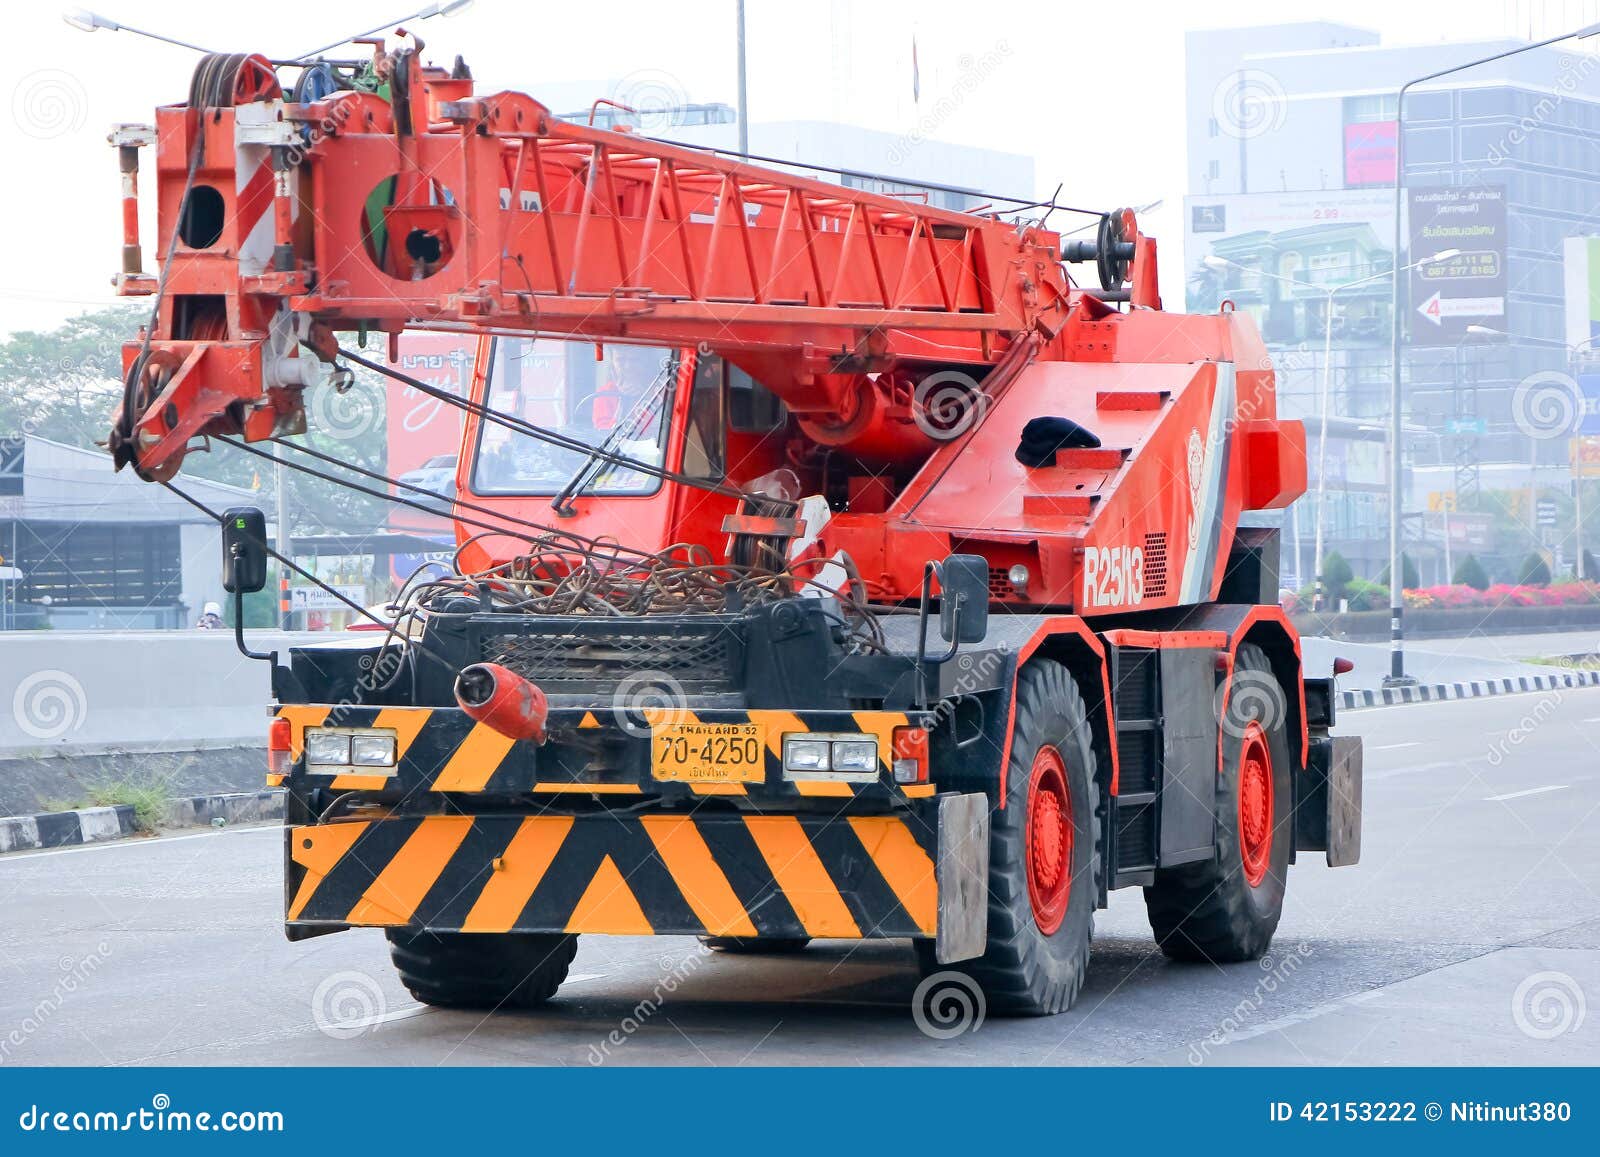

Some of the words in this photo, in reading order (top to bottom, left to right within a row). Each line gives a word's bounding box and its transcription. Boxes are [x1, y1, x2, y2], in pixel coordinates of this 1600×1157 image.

[1426, 298, 1440, 317] 4
[1083, 544, 1144, 608] R25/13
[679, 726, 739, 735] THAILAND
[660, 737, 759, 765] 70-4250
